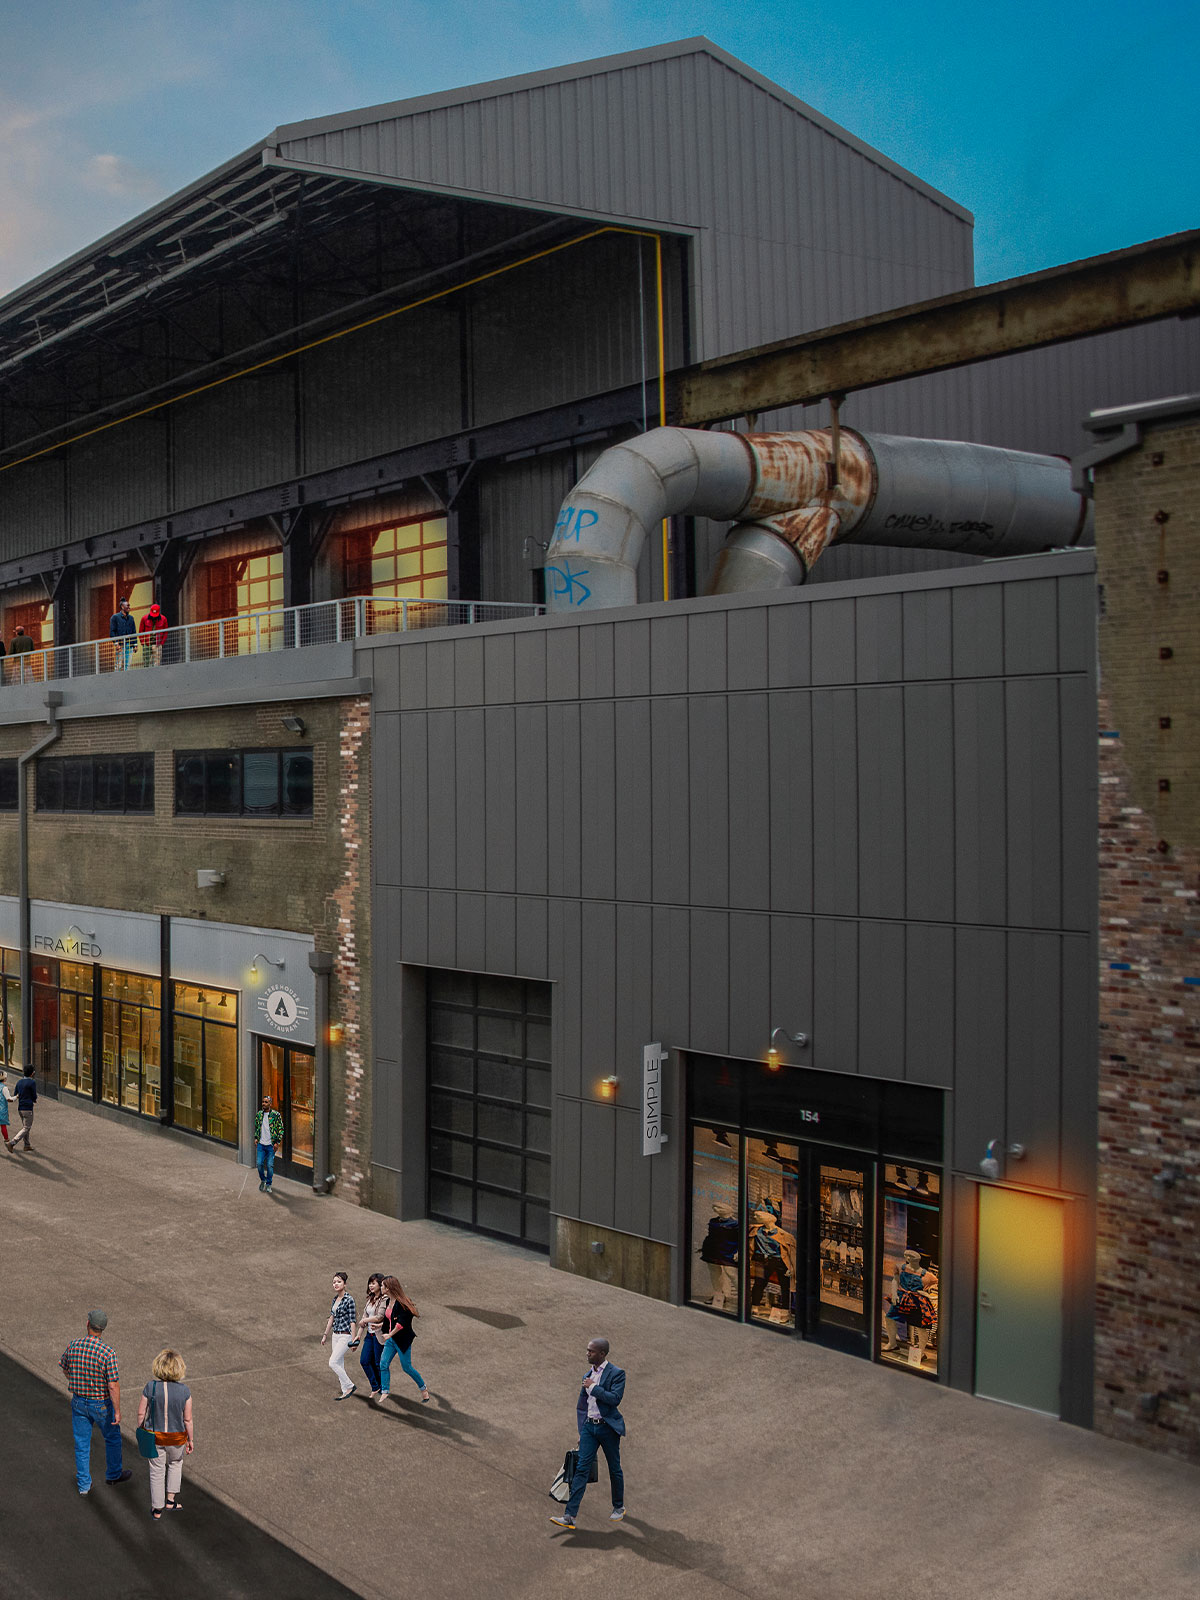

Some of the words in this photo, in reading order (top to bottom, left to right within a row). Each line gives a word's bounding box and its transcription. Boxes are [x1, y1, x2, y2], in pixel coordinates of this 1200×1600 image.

[34, 934, 103, 958] FRAMED
[264, 984, 300, 1002] TREEHOUSE
[263, 1013, 301, 1033] RESTAURANT
[646, 1058, 659, 1139] SIMPLE
[800, 1109, 820, 1124] 154
